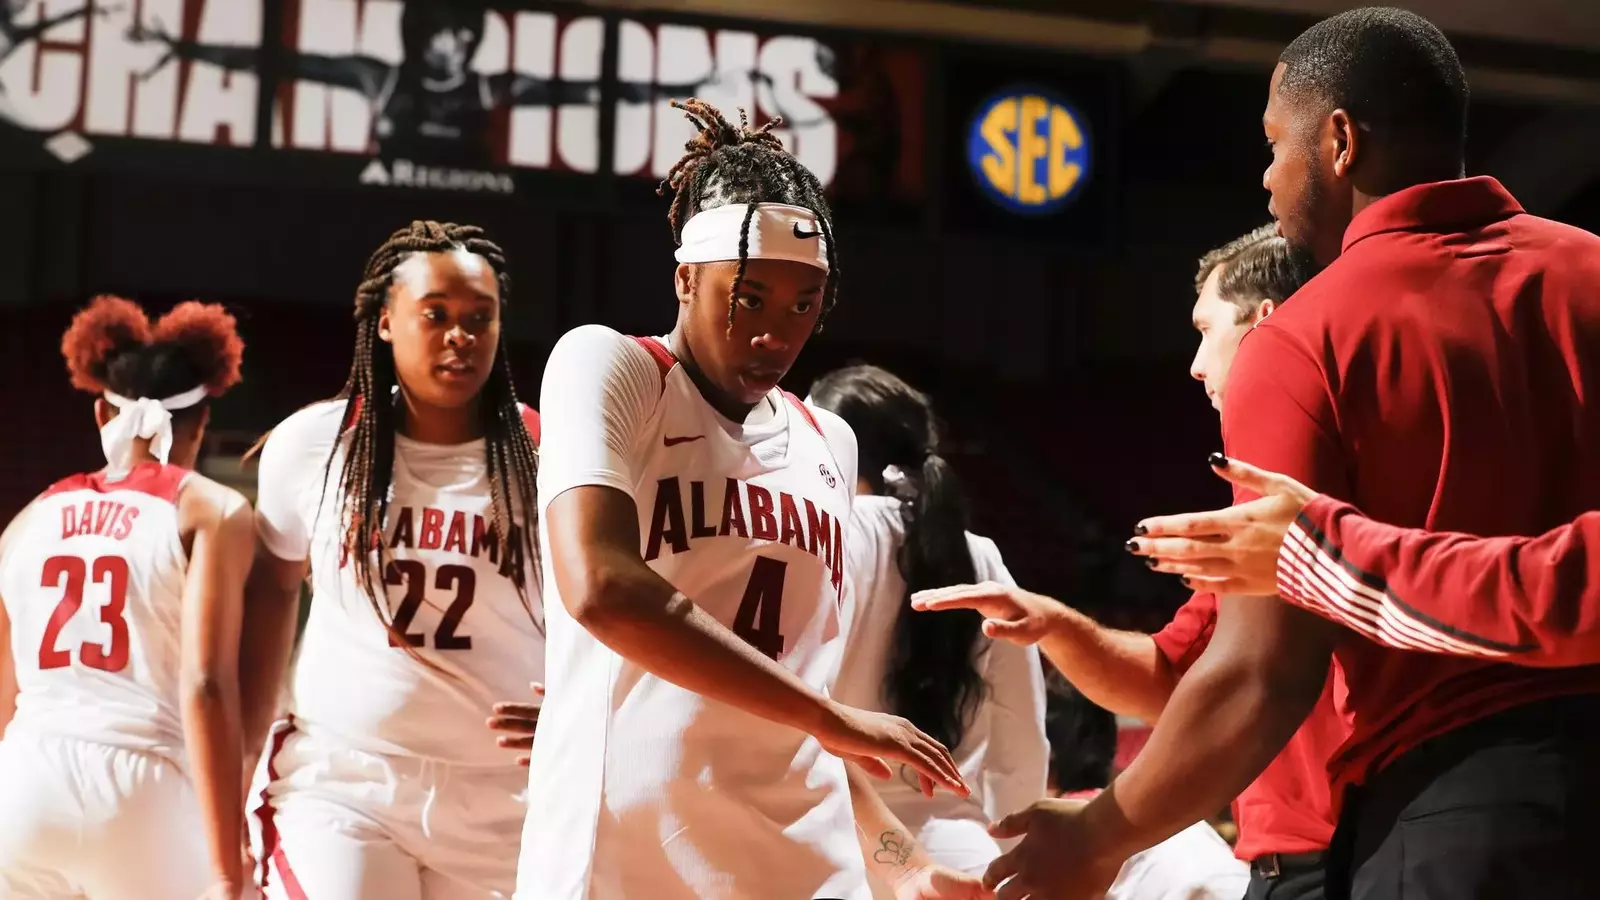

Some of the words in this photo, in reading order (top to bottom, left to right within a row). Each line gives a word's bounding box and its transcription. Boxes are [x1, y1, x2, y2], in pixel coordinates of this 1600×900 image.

[980, 95, 1083, 204] SEC
[62, 500, 140, 540] DAVIS
[339, 506, 526, 589] ABAMA
[644, 476, 844, 612] ALABAMA
[39, 555, 129, 672] 23
[386, 559, 476, 650] 22
[732, 555, 788, 662] 4
